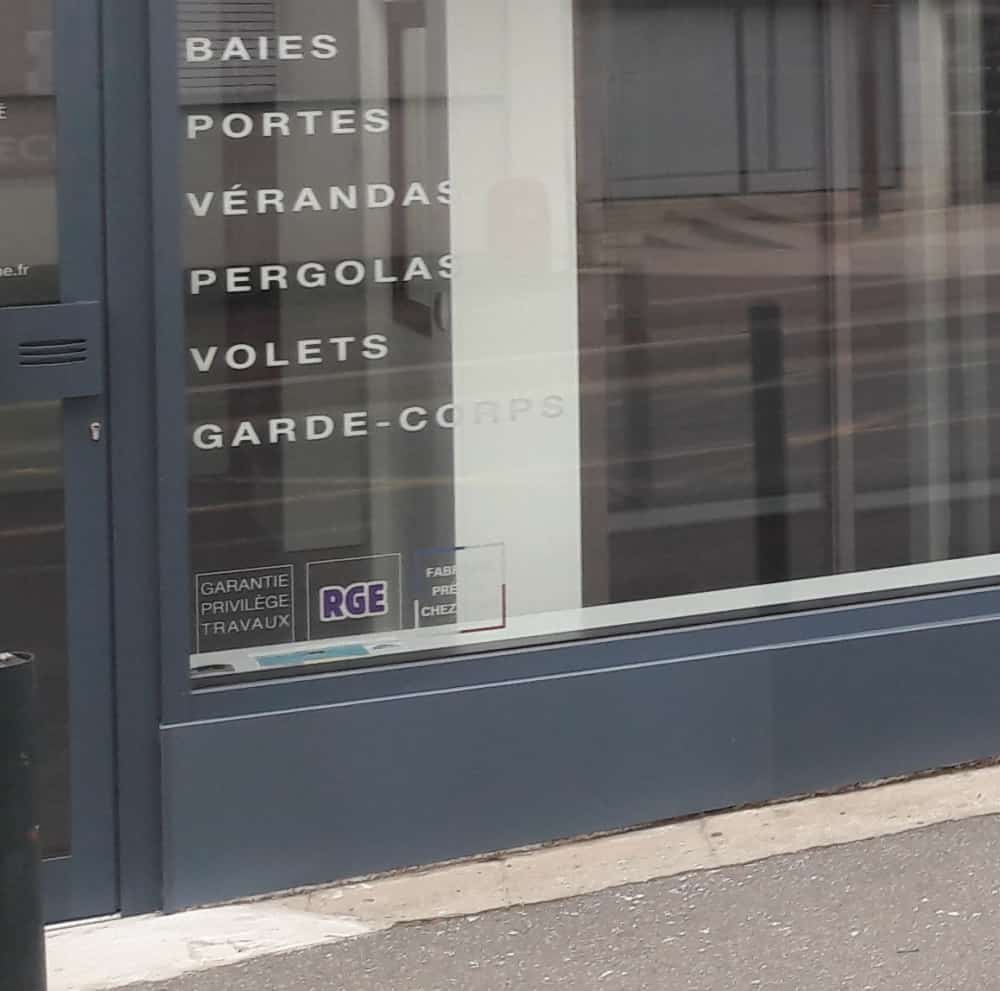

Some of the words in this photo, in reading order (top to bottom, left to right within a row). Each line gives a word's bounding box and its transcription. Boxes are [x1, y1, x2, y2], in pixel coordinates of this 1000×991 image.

[185, 34, 339, 63] BAIES
[186, 108, 390, 139] PORTES
[186, 179, 453, 218] VÉRANDAS
[190, 254, 454, 295] PERGOLAS
[189, 334, 389, 372] VOLETS
[200, 573, 290, 596] GARANTIE
[200, 593, 290, 616] PRIVILÈGE
[320, 580, 388, 622] RGE
[201, 613, 291, 636] TRAVAUX
